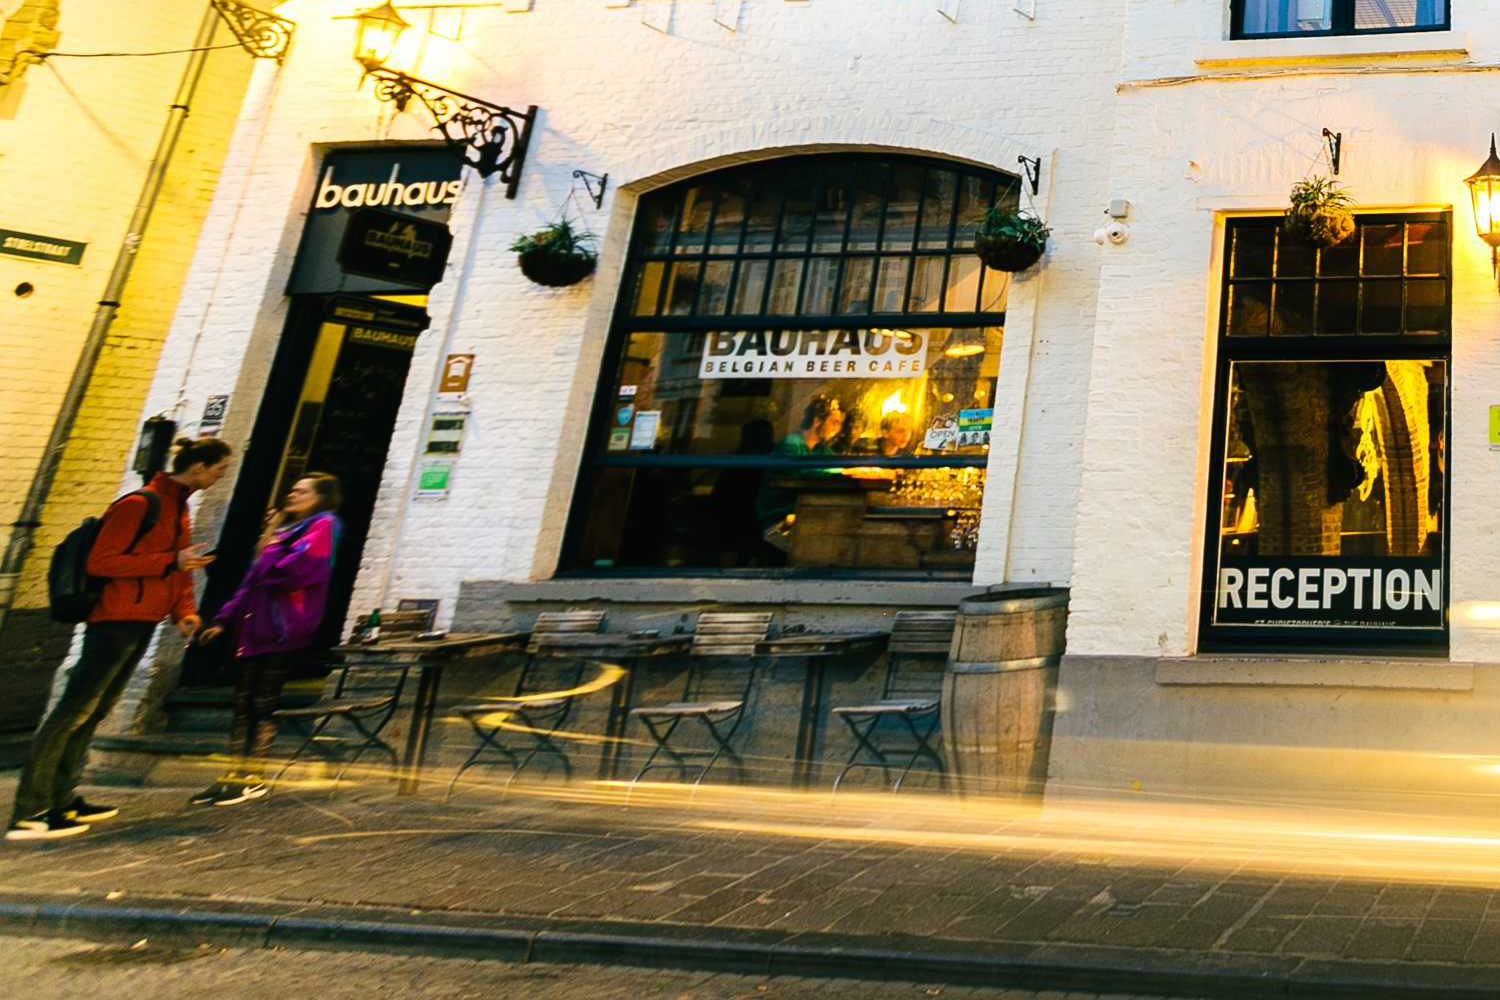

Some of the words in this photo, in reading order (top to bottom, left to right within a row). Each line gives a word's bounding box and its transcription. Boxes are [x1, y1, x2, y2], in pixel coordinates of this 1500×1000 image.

[315, 163, 464, 208] bauhaus
[707, 329, 923, 357] BAUHAUS
[704, 361, 794, 373] BELGIAN
[805, 360, 856, 373] BEER
[868, 360, 921, 372] CAFE
[930, 429, 956, 439] OPEN
[1219, 568, 1440, 610] RECEPTION
